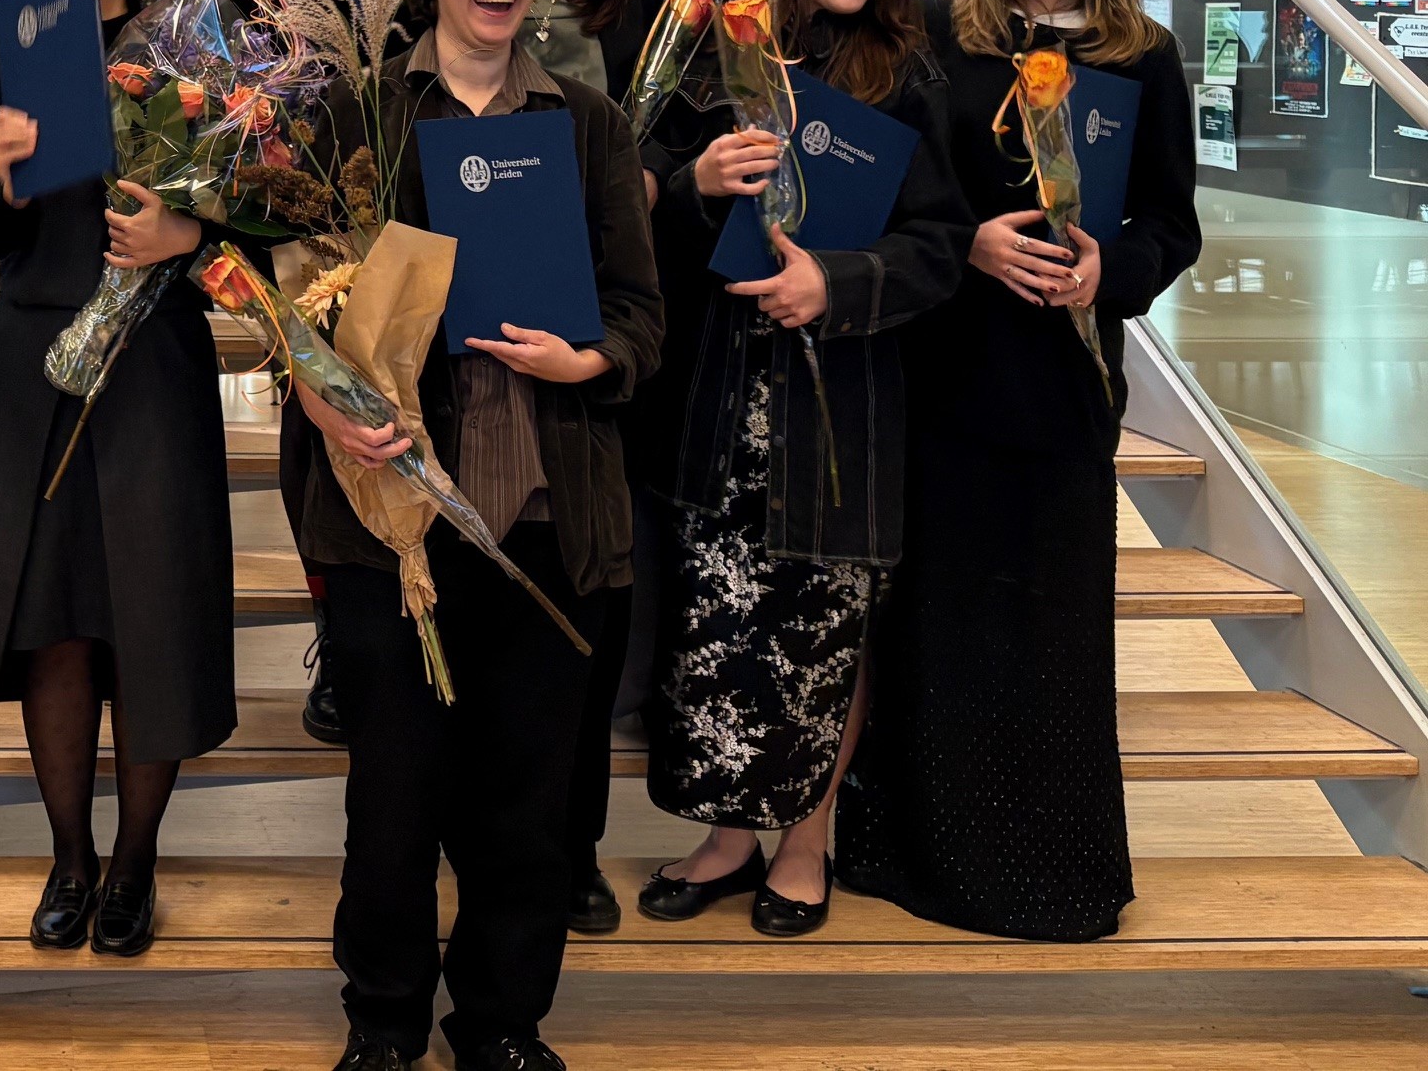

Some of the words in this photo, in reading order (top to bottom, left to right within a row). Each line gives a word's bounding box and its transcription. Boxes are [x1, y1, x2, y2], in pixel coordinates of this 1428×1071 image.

[829, 145, 855, 165] Leiden
[833, 135, 876, 164] Universiteit
[491, 156, 541, 169] Universiteit
[493, 168, 523, 179] Leiden
